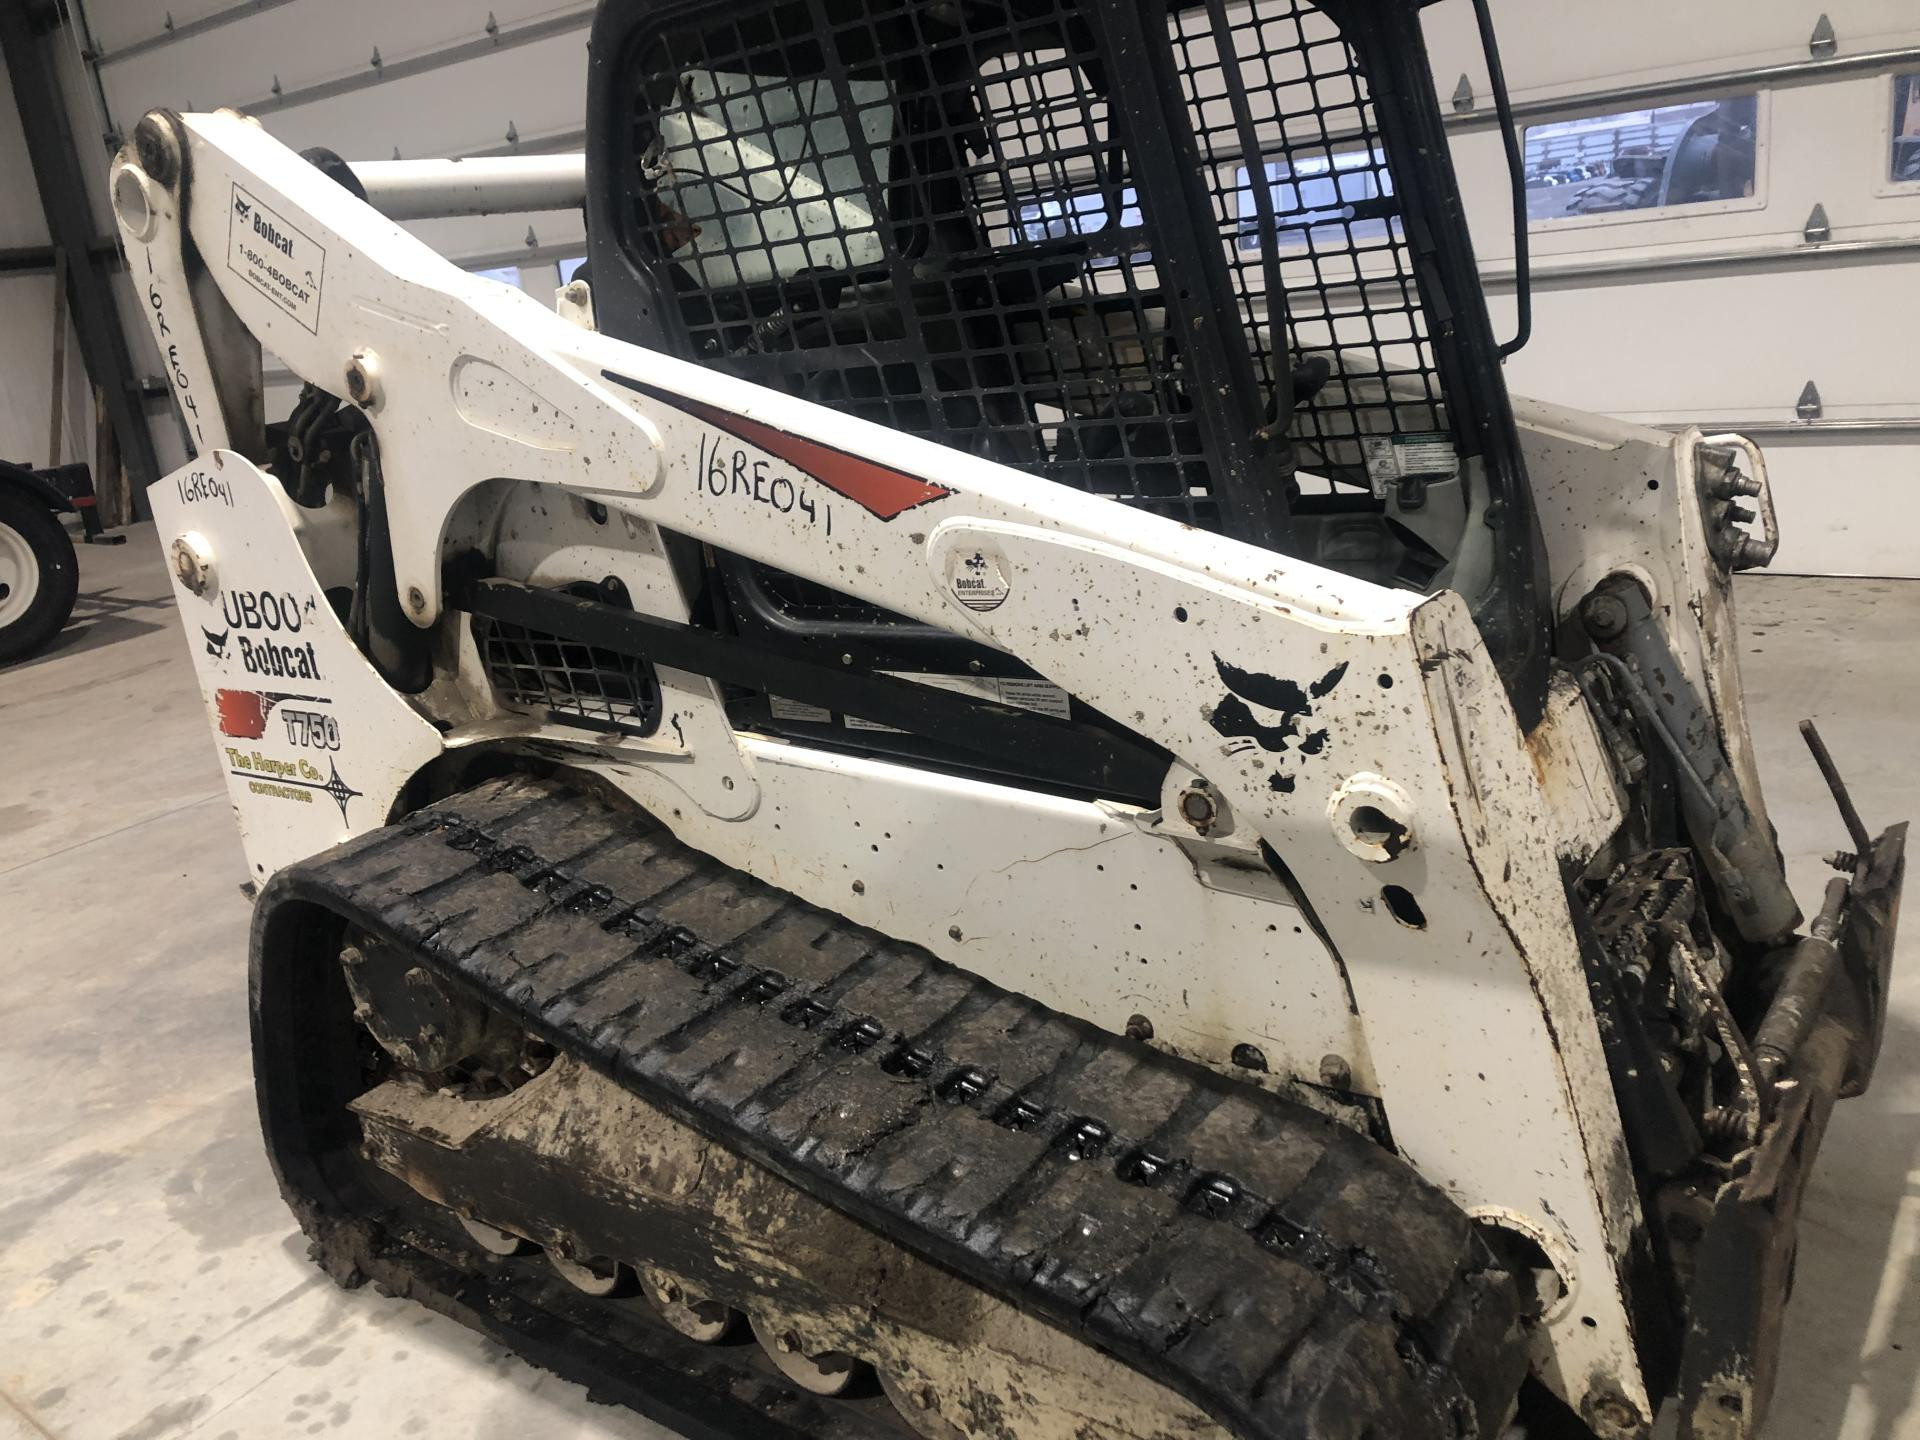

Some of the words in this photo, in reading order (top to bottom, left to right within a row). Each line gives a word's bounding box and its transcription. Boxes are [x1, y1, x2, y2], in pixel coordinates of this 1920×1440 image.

[253, 211, 294, 259] Bobcat
[239, 243, 311, 304] 1-800-4BOBCAT
[177, 472, 235, 508] 16RE041
[698, 432, 831, 536] 16RE041
[956, 578, 986, 589] Bobcat
[237, 635, 321, 681] Bobcat
[281, 709, 341, 752] T750
[225, 747, 252, 770] The
[251, 751, 297, 779] Harper
[298, 759, 324, 781] Co.
[248, 780, 313, 804] CONTRACTORS
